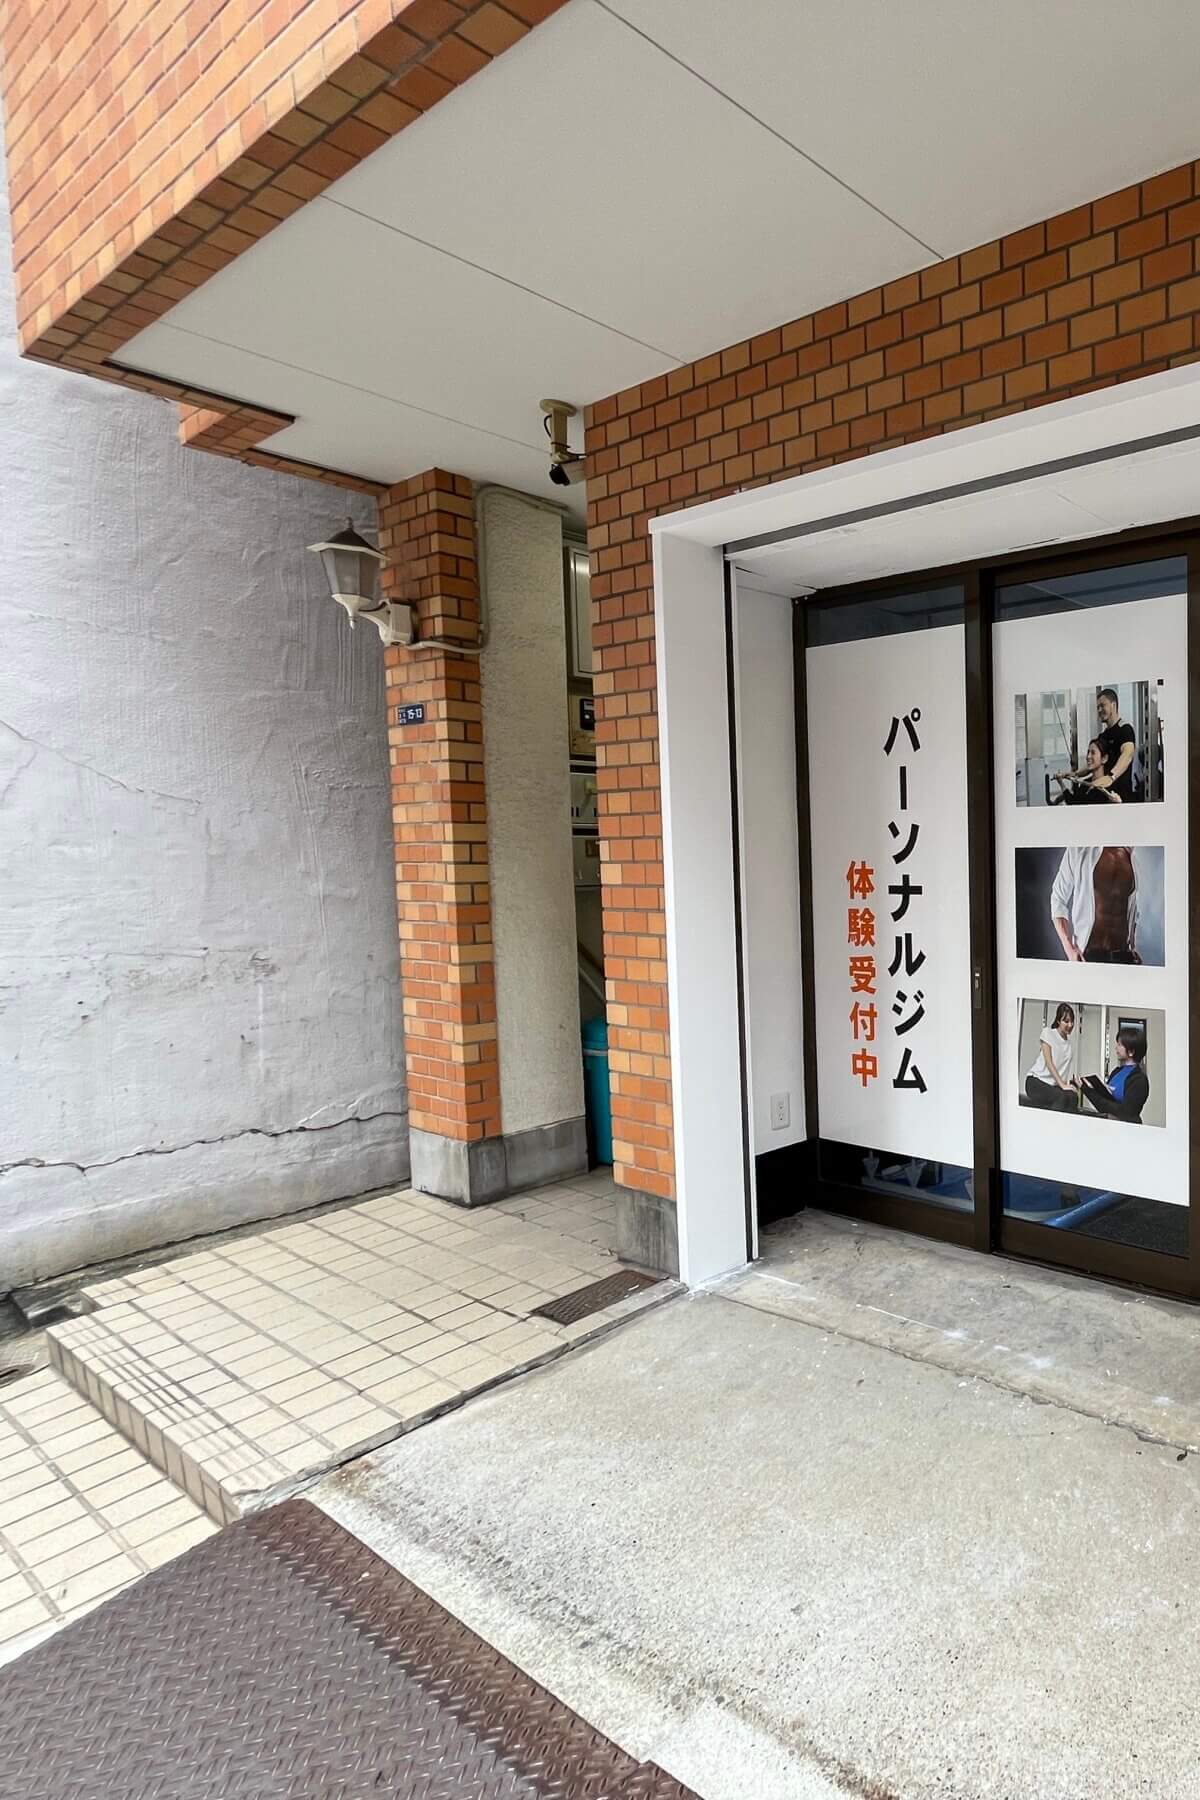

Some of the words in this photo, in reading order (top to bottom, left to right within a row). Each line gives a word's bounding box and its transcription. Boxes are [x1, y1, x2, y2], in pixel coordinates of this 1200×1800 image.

[846, 861, 879, 1089] 体験受付中
[884, 708, 927, 1093] パーソナルジム
